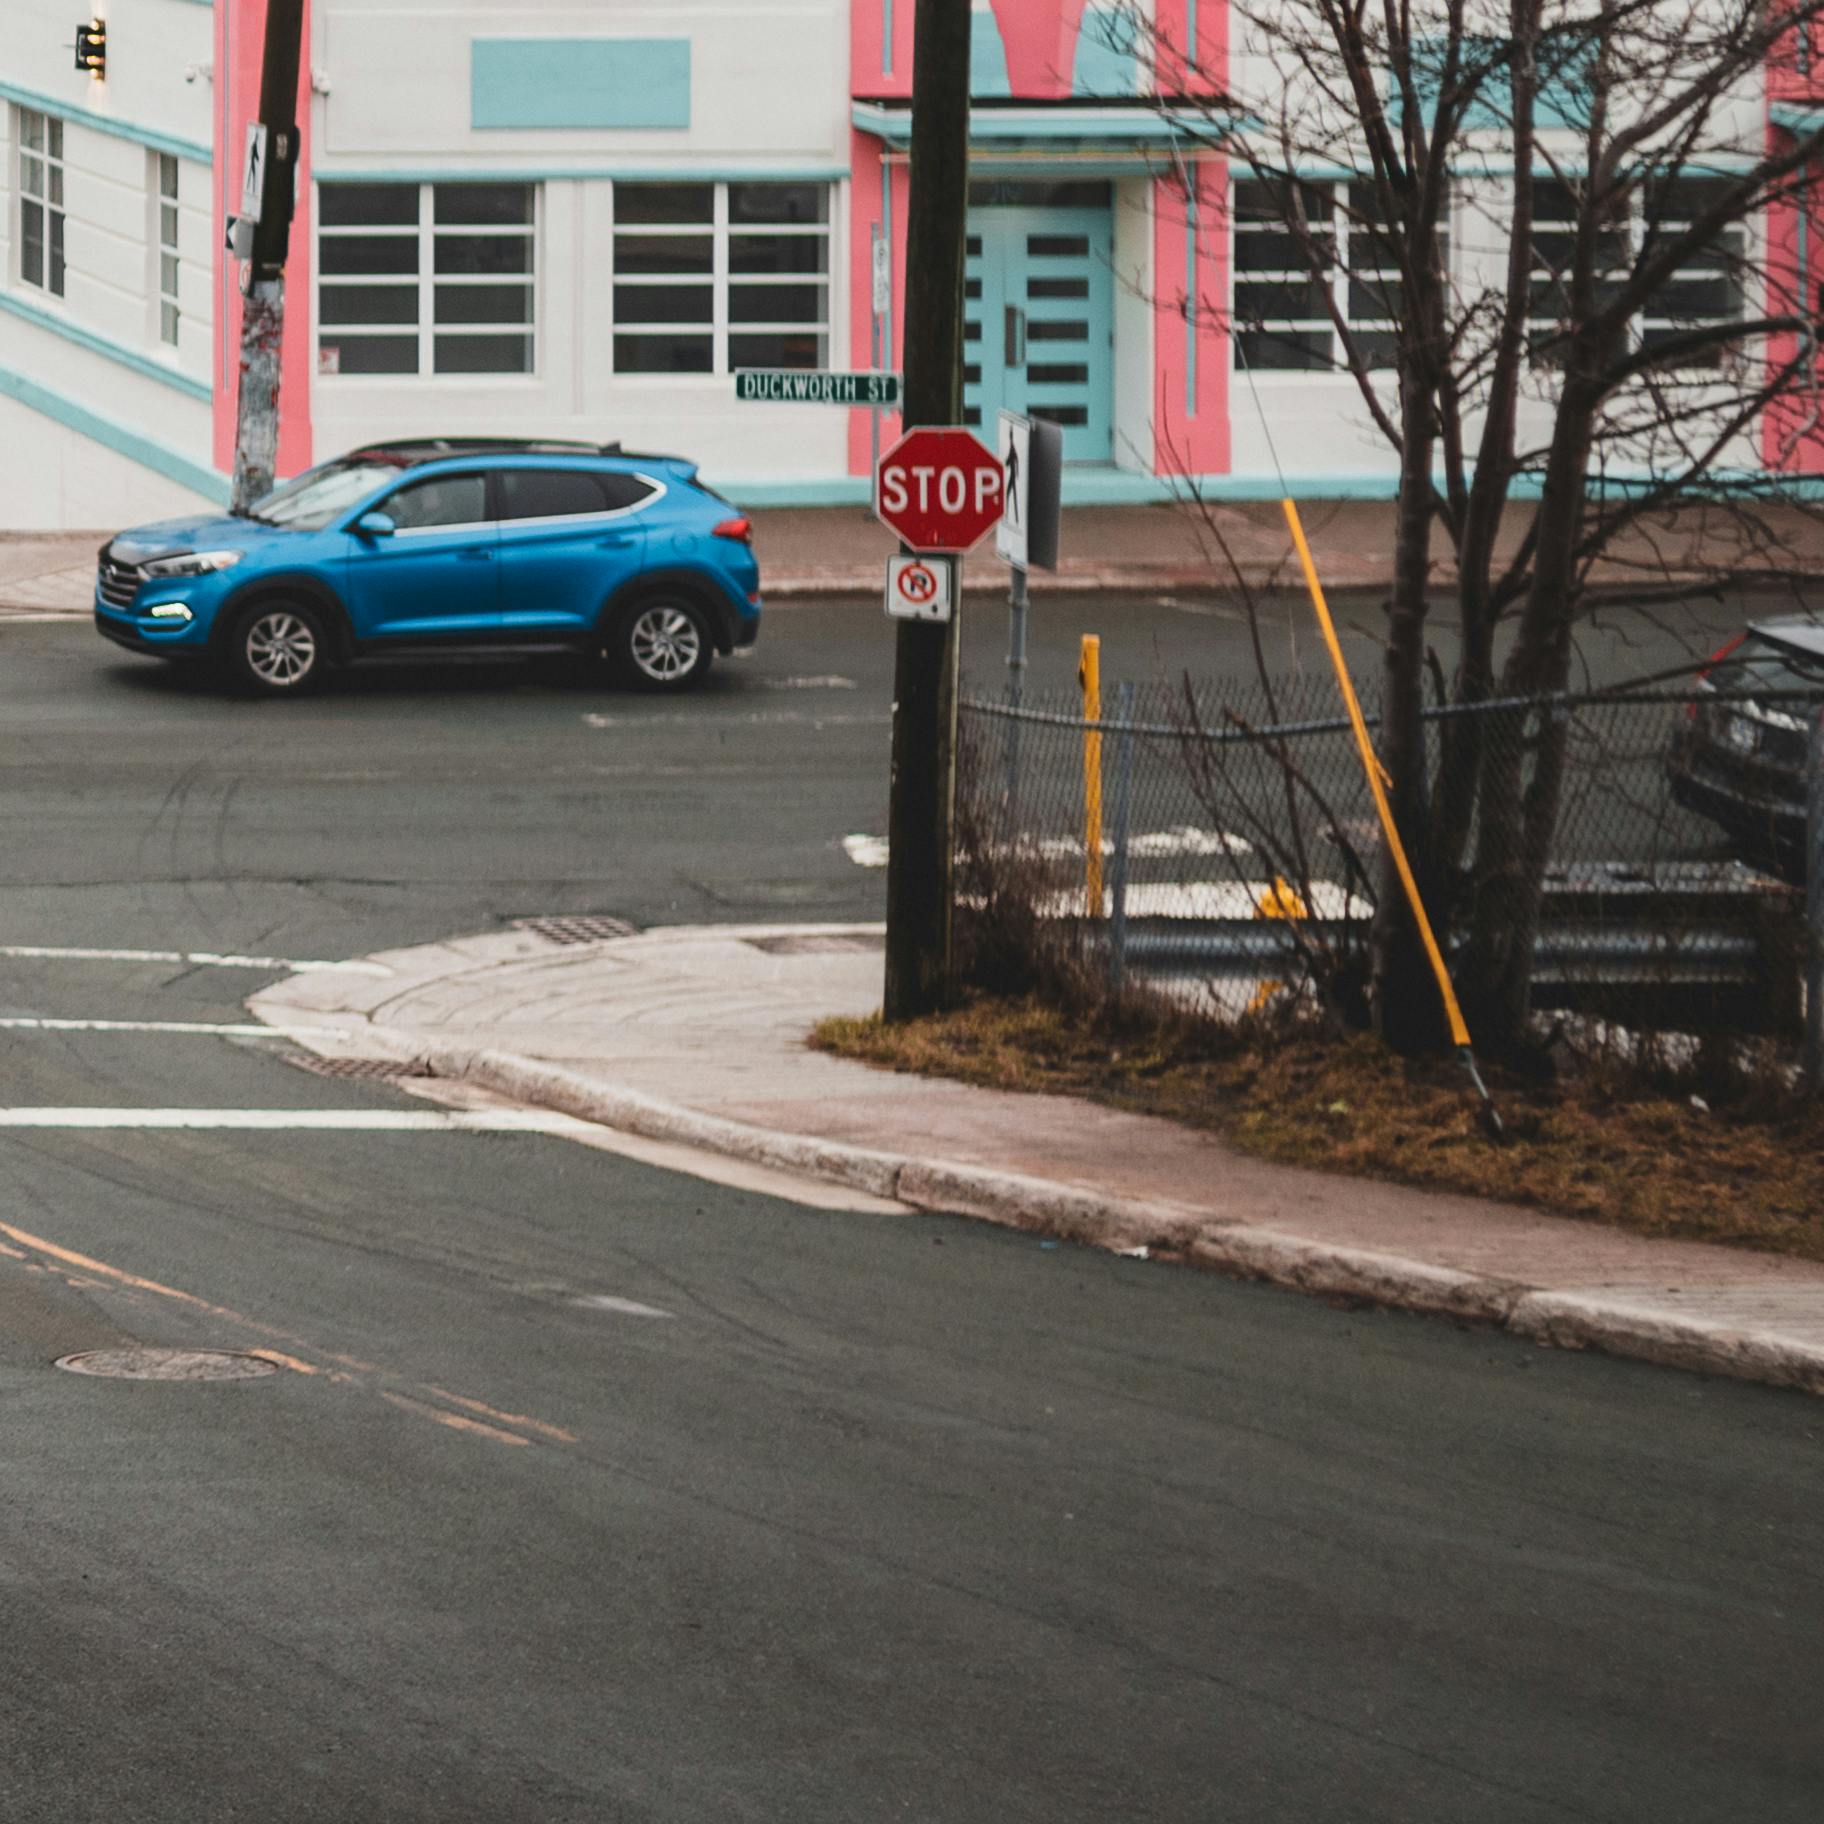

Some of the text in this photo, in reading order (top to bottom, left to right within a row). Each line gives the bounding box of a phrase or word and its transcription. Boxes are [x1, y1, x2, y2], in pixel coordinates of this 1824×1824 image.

[744, 374, 889, 402] DUCKWORTH ST
[883, 466, 1001, 514] STOP
